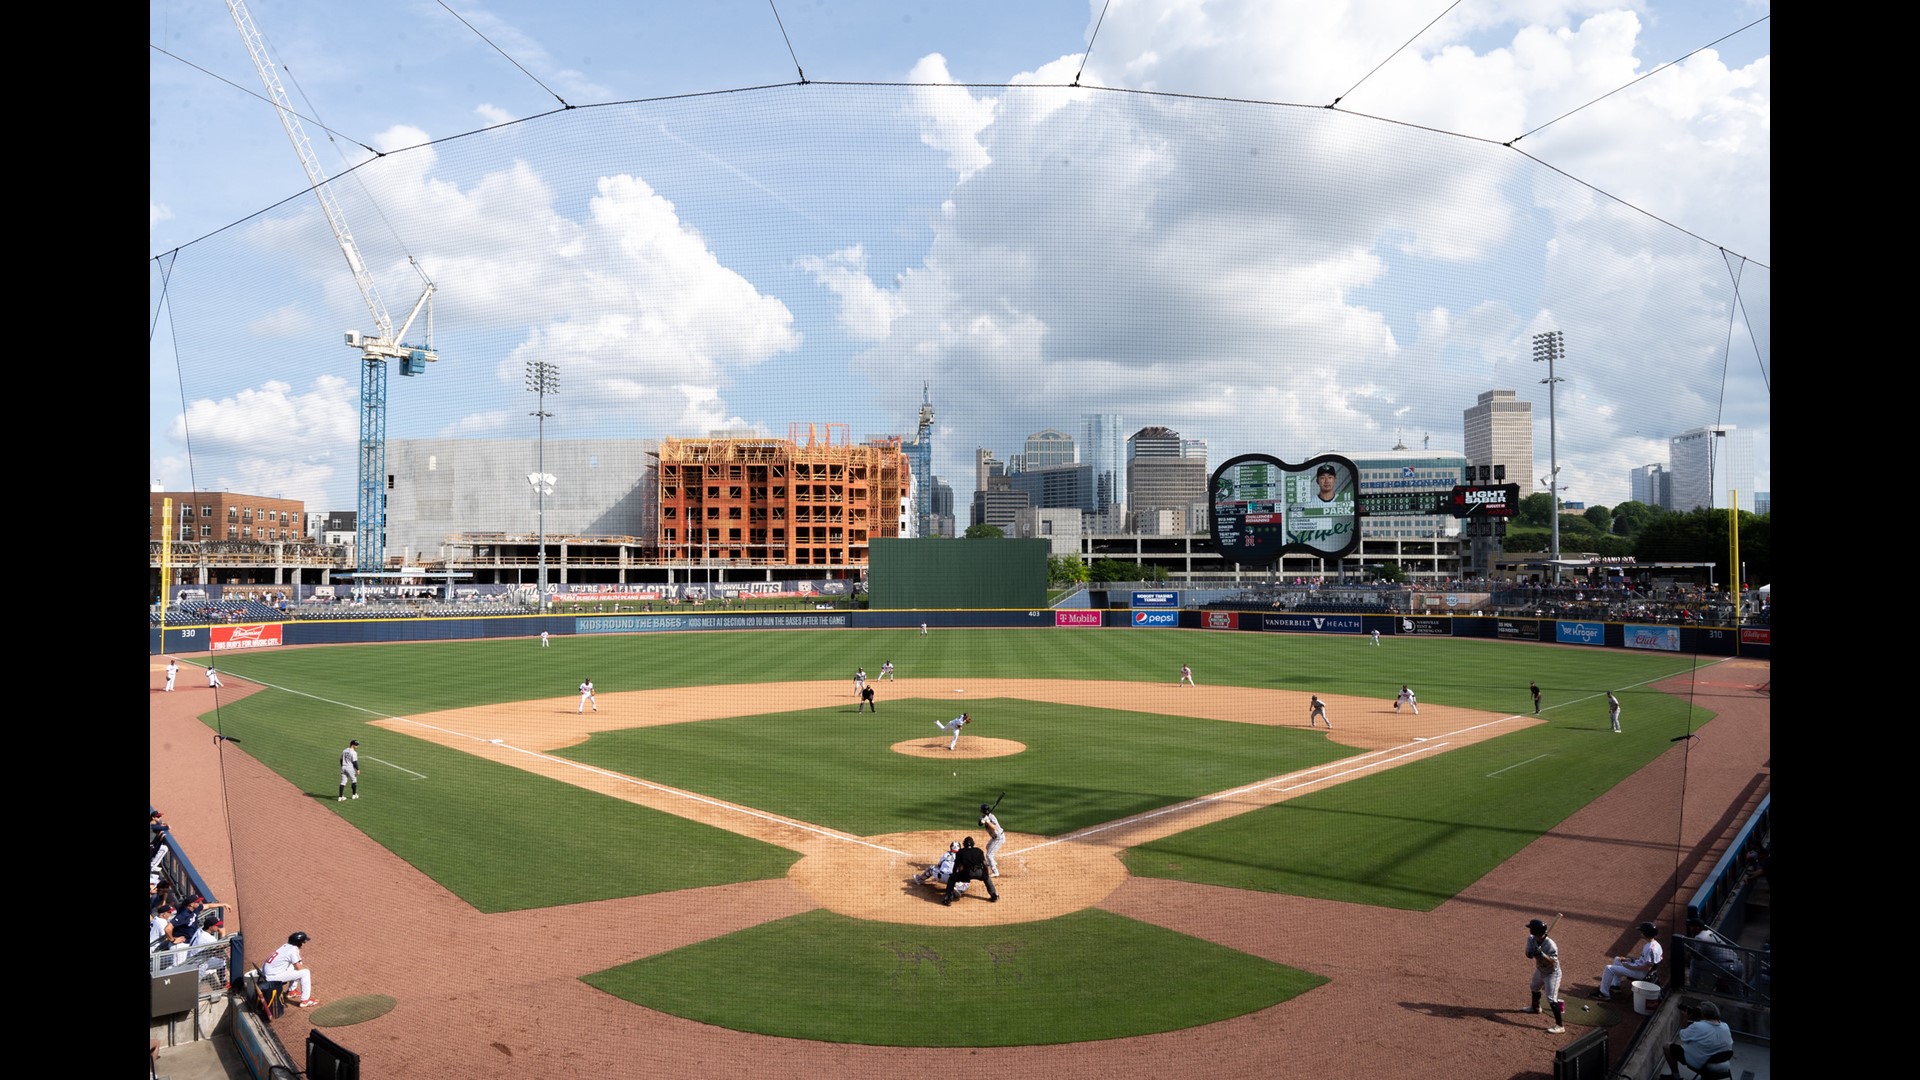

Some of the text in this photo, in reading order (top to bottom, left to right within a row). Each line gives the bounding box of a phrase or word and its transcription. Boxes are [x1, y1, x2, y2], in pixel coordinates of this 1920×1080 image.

[753, 583, 779, 592] HITS
[580, 620, 601, 630] KIDS
[602, 620, 634, 629] ROUND
[636, 619, 652, 628] THE
[655, 618, 682, 627] BASES
[688, 618, 701, 627] KIDS
[701, 617, 715, 627] MEET
[716, 617, 723, 626] AT
[724, 617, 746, 626] SECTION
[755, 616, 762, 626] TO
[762, 616, 774, 626] RUN
[775, 616, 785, 625] THE
[785, 616, 801, 625] BASES
[802, 616, 818, 625] AFTER
[819, 616, 828, 625] THE
[1069, 614, 1097, 623] Mobile
[1149, 614, 1174, 623] pepsi
[182, 629, 196, 638] 330
[214, 642, 225, 650] THIS
[252, 639, 267, 647] MUSIC
[1636, 635, 1658, 645] Chill
